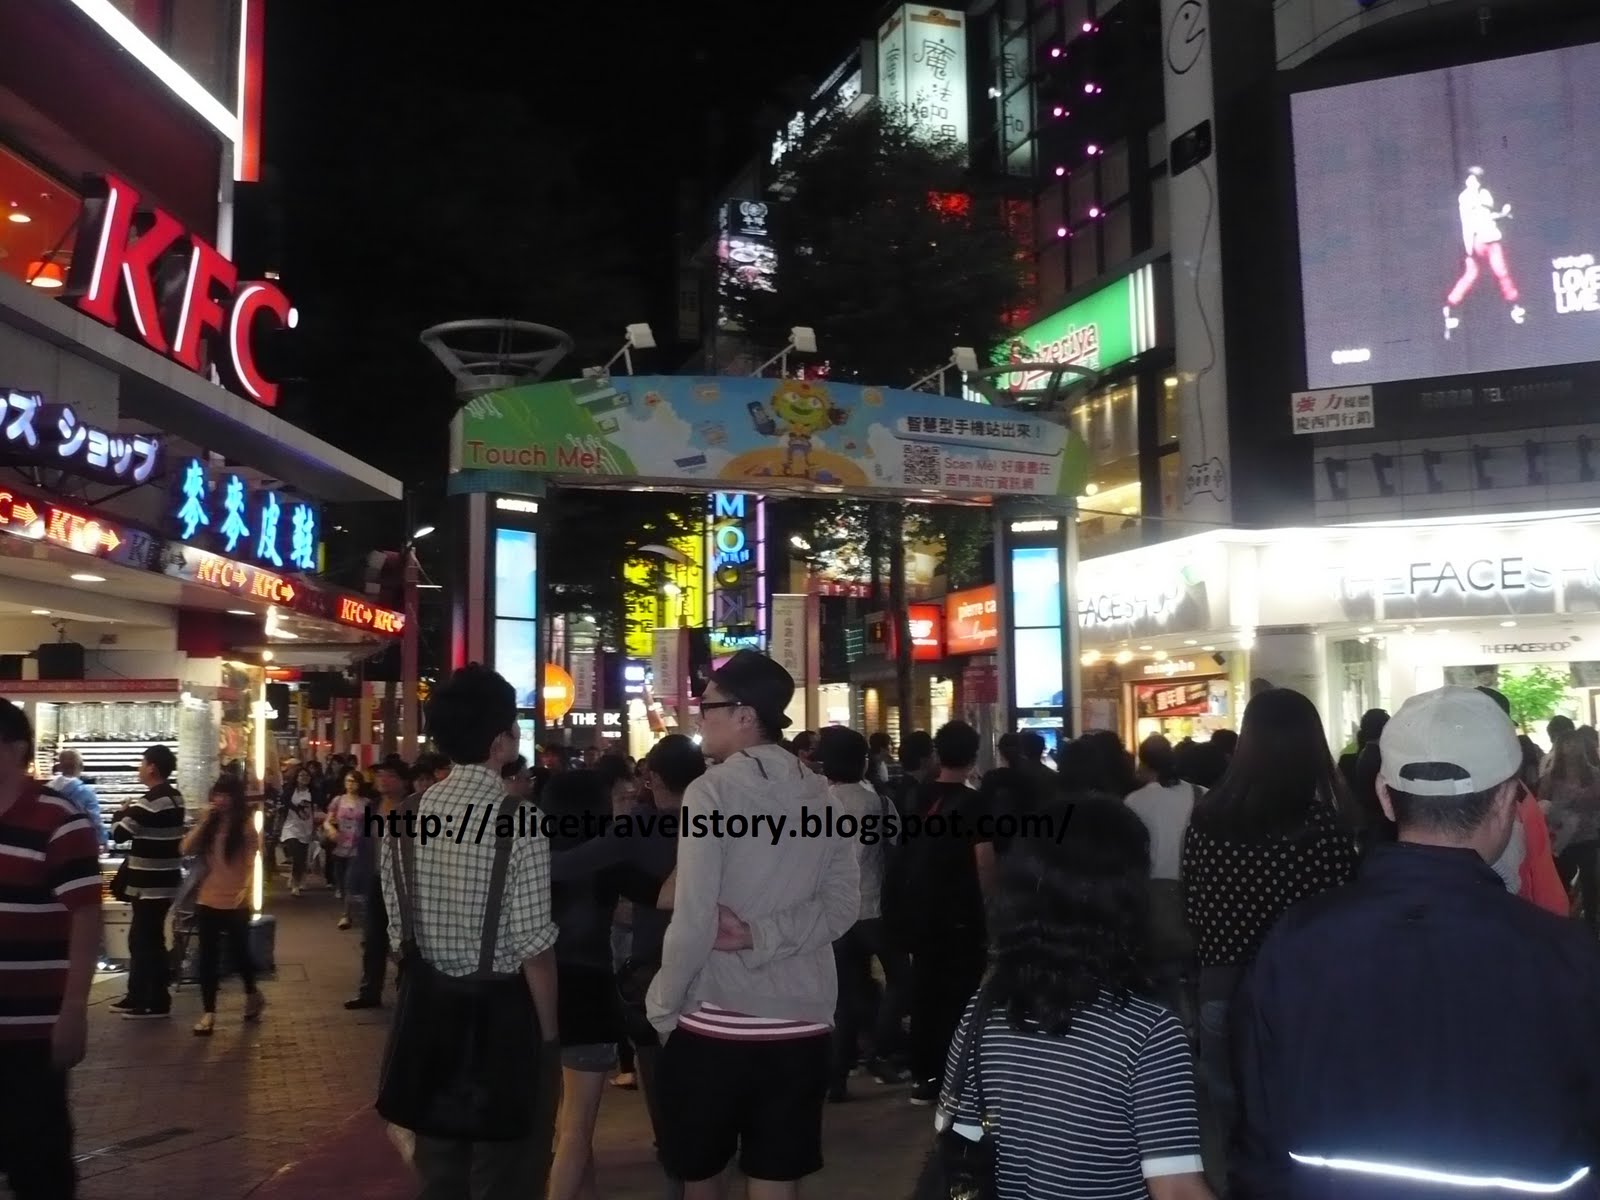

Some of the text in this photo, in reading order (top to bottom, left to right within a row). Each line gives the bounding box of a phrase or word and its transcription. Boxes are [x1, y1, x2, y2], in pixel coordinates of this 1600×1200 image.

[76, 172, 298, 407] KFC
[466, 440, 602, 469] Touch Me!
[945, 457, 973, 471] Scan
[47, 508, 100, 551] KFC
[196, 556, 232, 587] KFC
[250, 570, 283, 601] KFC
[341, 598, 364, 623] KFC
[373, 609, 395, 632] KFC
[1480, 641, 1571, 654] THEFACESHOP
[570, 712, 597, 726] THE
